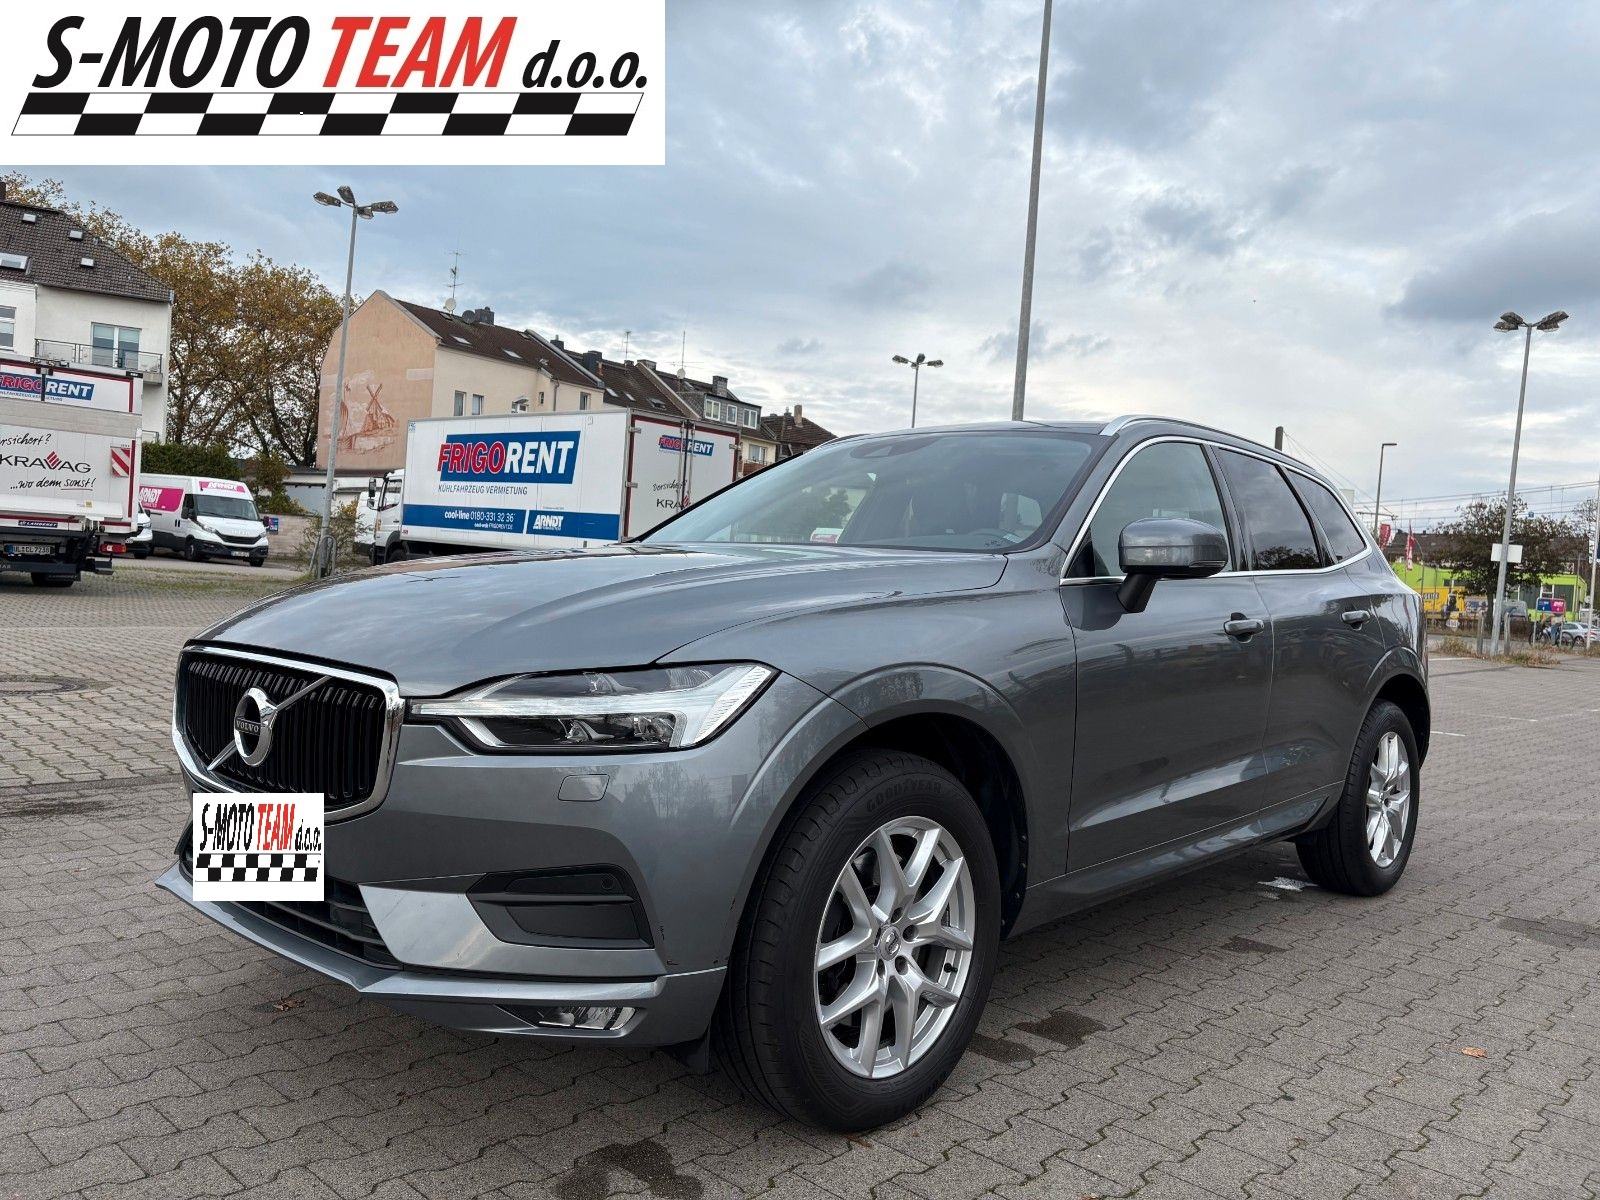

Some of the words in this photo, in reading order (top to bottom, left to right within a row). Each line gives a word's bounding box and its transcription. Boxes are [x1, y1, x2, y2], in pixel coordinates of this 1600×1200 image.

[0, 453, 92, 474] KRAVAG
[437, 441, 575, 474] FRIGORENT
[36, 477, 61, 488] denn
[64, 477, 97, 488] sonst!
[438, 484, 485, 494] KÜHLFAHRZEUG
[486, 486, 528, 496] VERMIETUNG
[496, 512, 505, 522] 32
[533, 514, 564, 529] ARNDT
[236, 719, 260, 733] VOLVO
